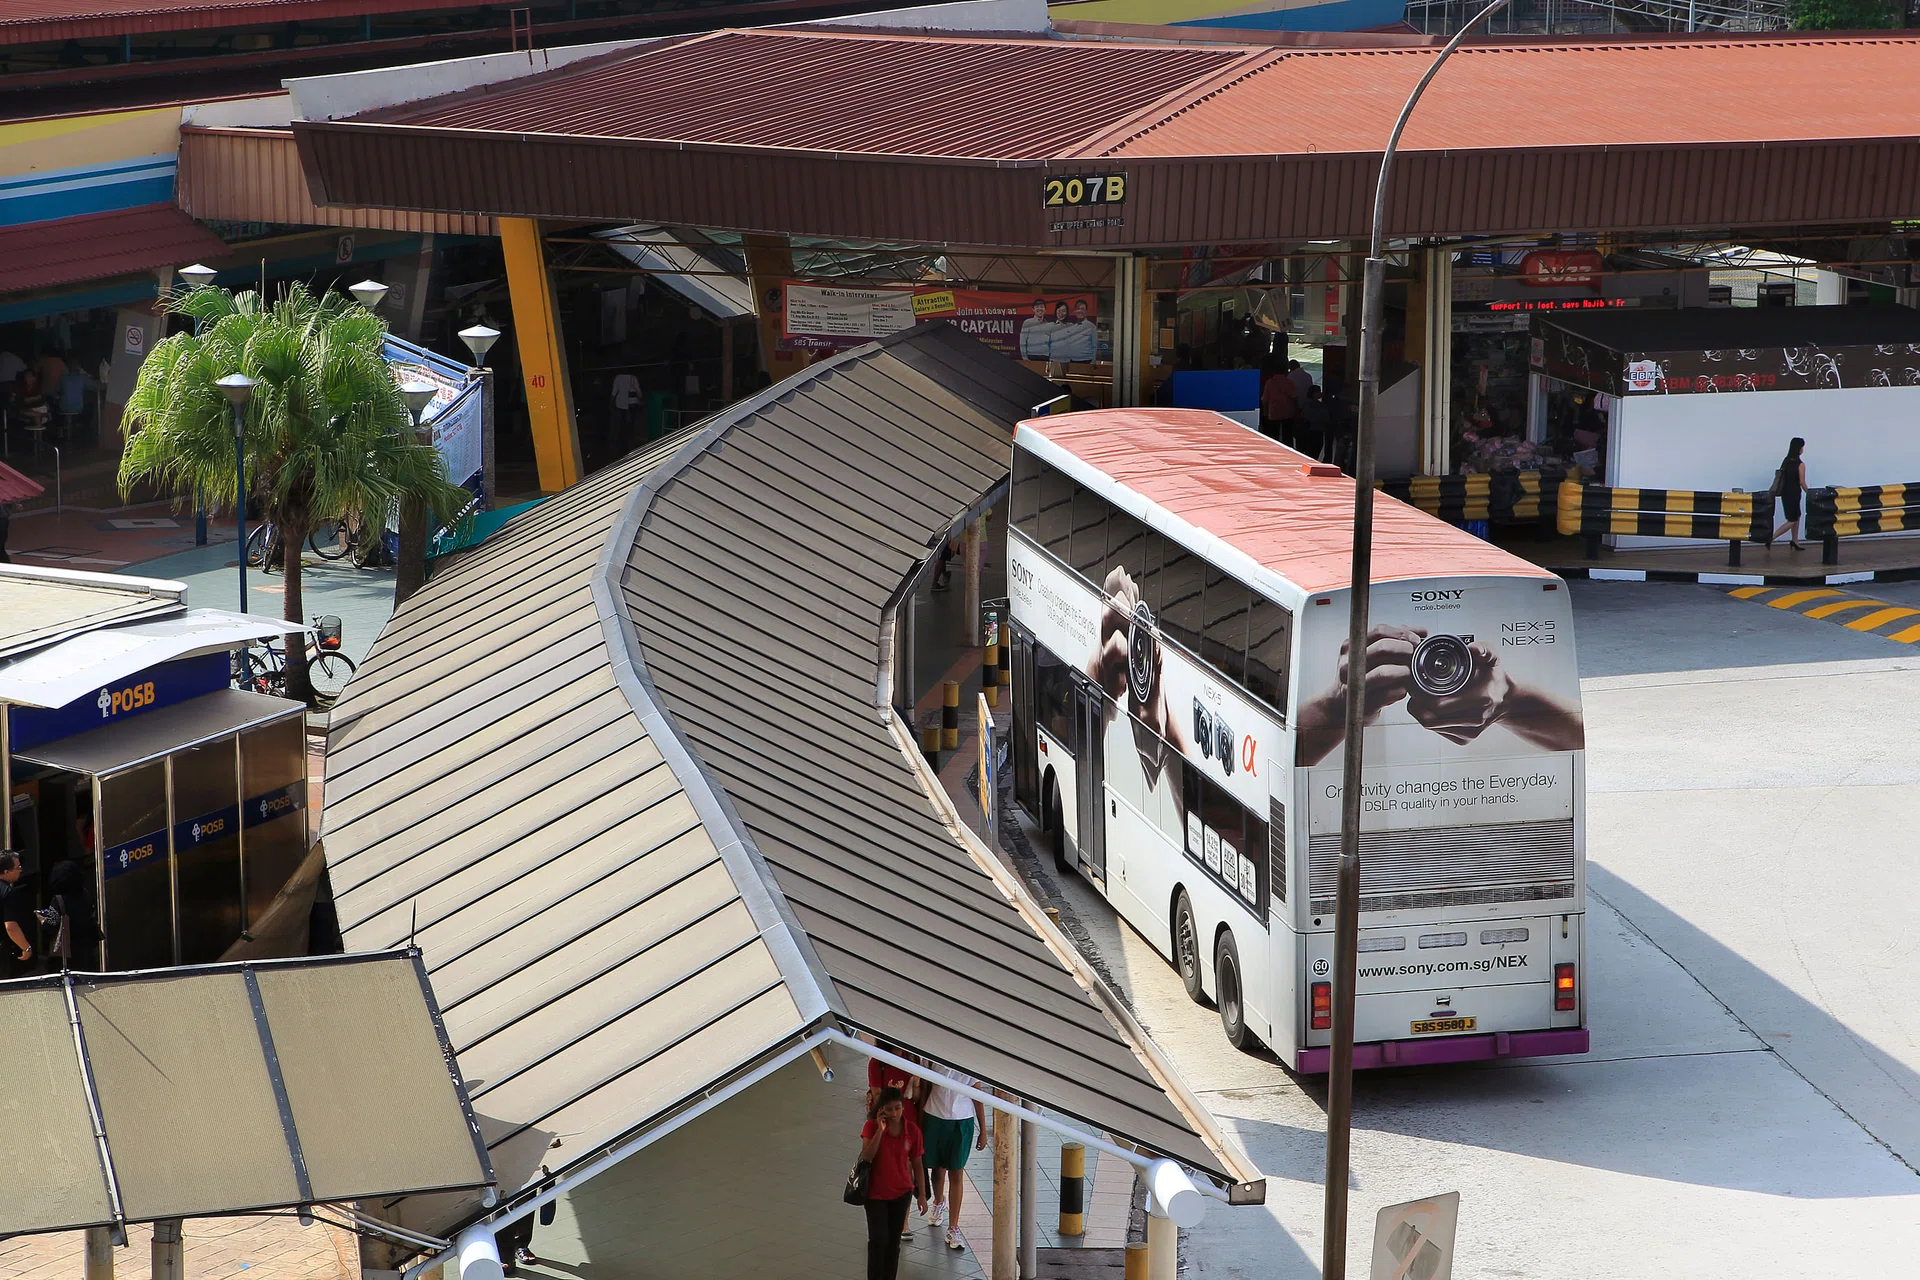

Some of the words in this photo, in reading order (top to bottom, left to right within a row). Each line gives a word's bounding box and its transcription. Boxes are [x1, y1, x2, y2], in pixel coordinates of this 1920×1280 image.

[1046, 176, 1124, 205] 207B
[916, 295, 949, 306] Attractive
[1491, 302, 1521, 311] support
[1525, 301, 1534, 310] is
[956, 308, 973, 316] Join
[974, 308, 984, 316] us
[985, 307, 1007, 316] today
[960, 319, 1014, 335] CAPTAIN
[805, 337, 833, 347] Transit
[531, 374, 545, 388] 40
[1629, 371, 1656, 380] EBM
[1011, 559, 1034, 590] SONY
[1411, 589, 1465, 603] SONY
[1414, 603, 1461, 612] make.believe
[1501, 620, 1556, 633] NEX-5
[1501, 634, 1556, 646] NEX-3
[111, 681, 155, 715] POSB
[1203, 683, 1222, 706] NEX-5
[1325, 782, 1392, 799] Crtivity
[1396, 779, 1458, 796] changes
[1462, 776, 1485, 791] the
[1489, 773, 1557, 790] Everyday.
[268, 795, 291, 811] POSB
[1365, 799, 1398, 812] DSLR
[1401, 796, 1437, 812] quality
[1441, 796, 1450, 807] in
[1453, 797, 1478, 809] your
[1481, 793, 1519, 805] hands.
[201, 818, 225, 837] POSB
[128, 843, 153, 863] POSB
[1314, 961, 1328, 971] 60
[1358, 954, 1528, 978] www.sony.com.sg/NEX
